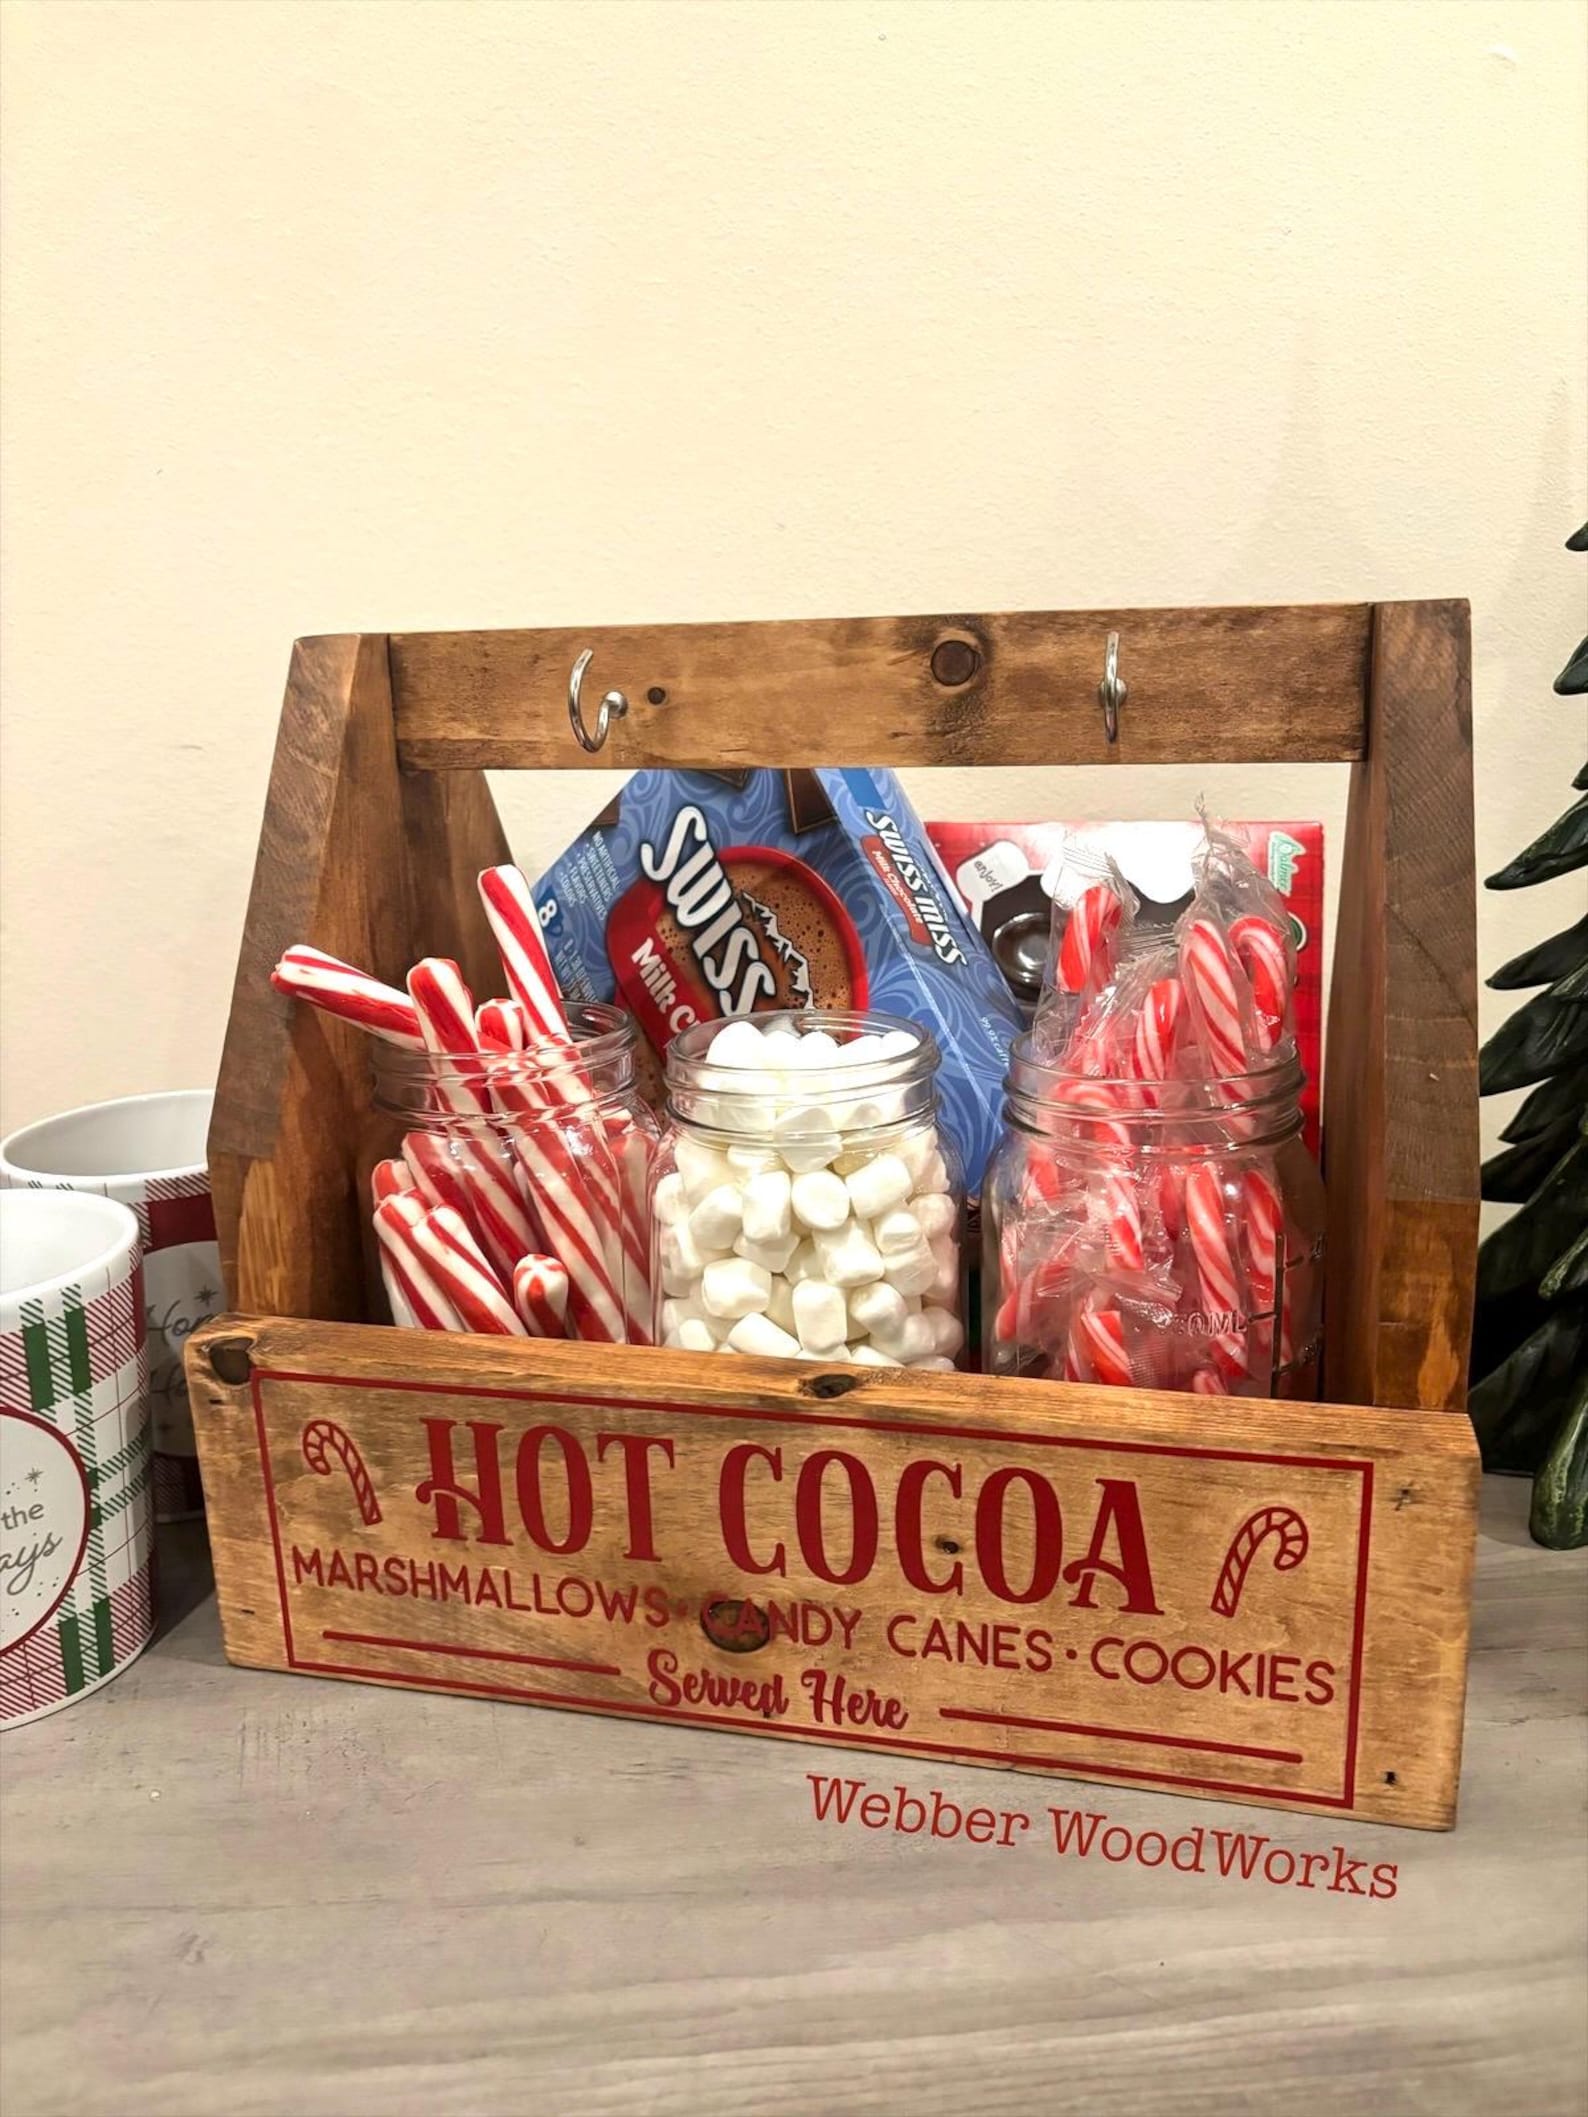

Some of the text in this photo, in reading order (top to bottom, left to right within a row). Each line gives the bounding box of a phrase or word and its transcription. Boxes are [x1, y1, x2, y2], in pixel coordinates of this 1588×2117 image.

[538, 898, 558, 929] 8
[577, 856, 608, 921] PRESERVATIVES
[640, 805, 776, 1016] SWISS
[866, 811, 968, 966] SWISS MISS
[871, 850, 925, 925] Milk Chocolate
[630, 936, 677, 1014] Milk
[0, 1502, 45, 1531] the
[414, 1417, 1165, 1617] HOT COCOA
[0, 1531, 64, 1596] ays
[291, 1545, 1336, 1706] MARSHMALLOWS CANDY CANES COOKIES
[647, 1648, 910, 1731] Served Here
